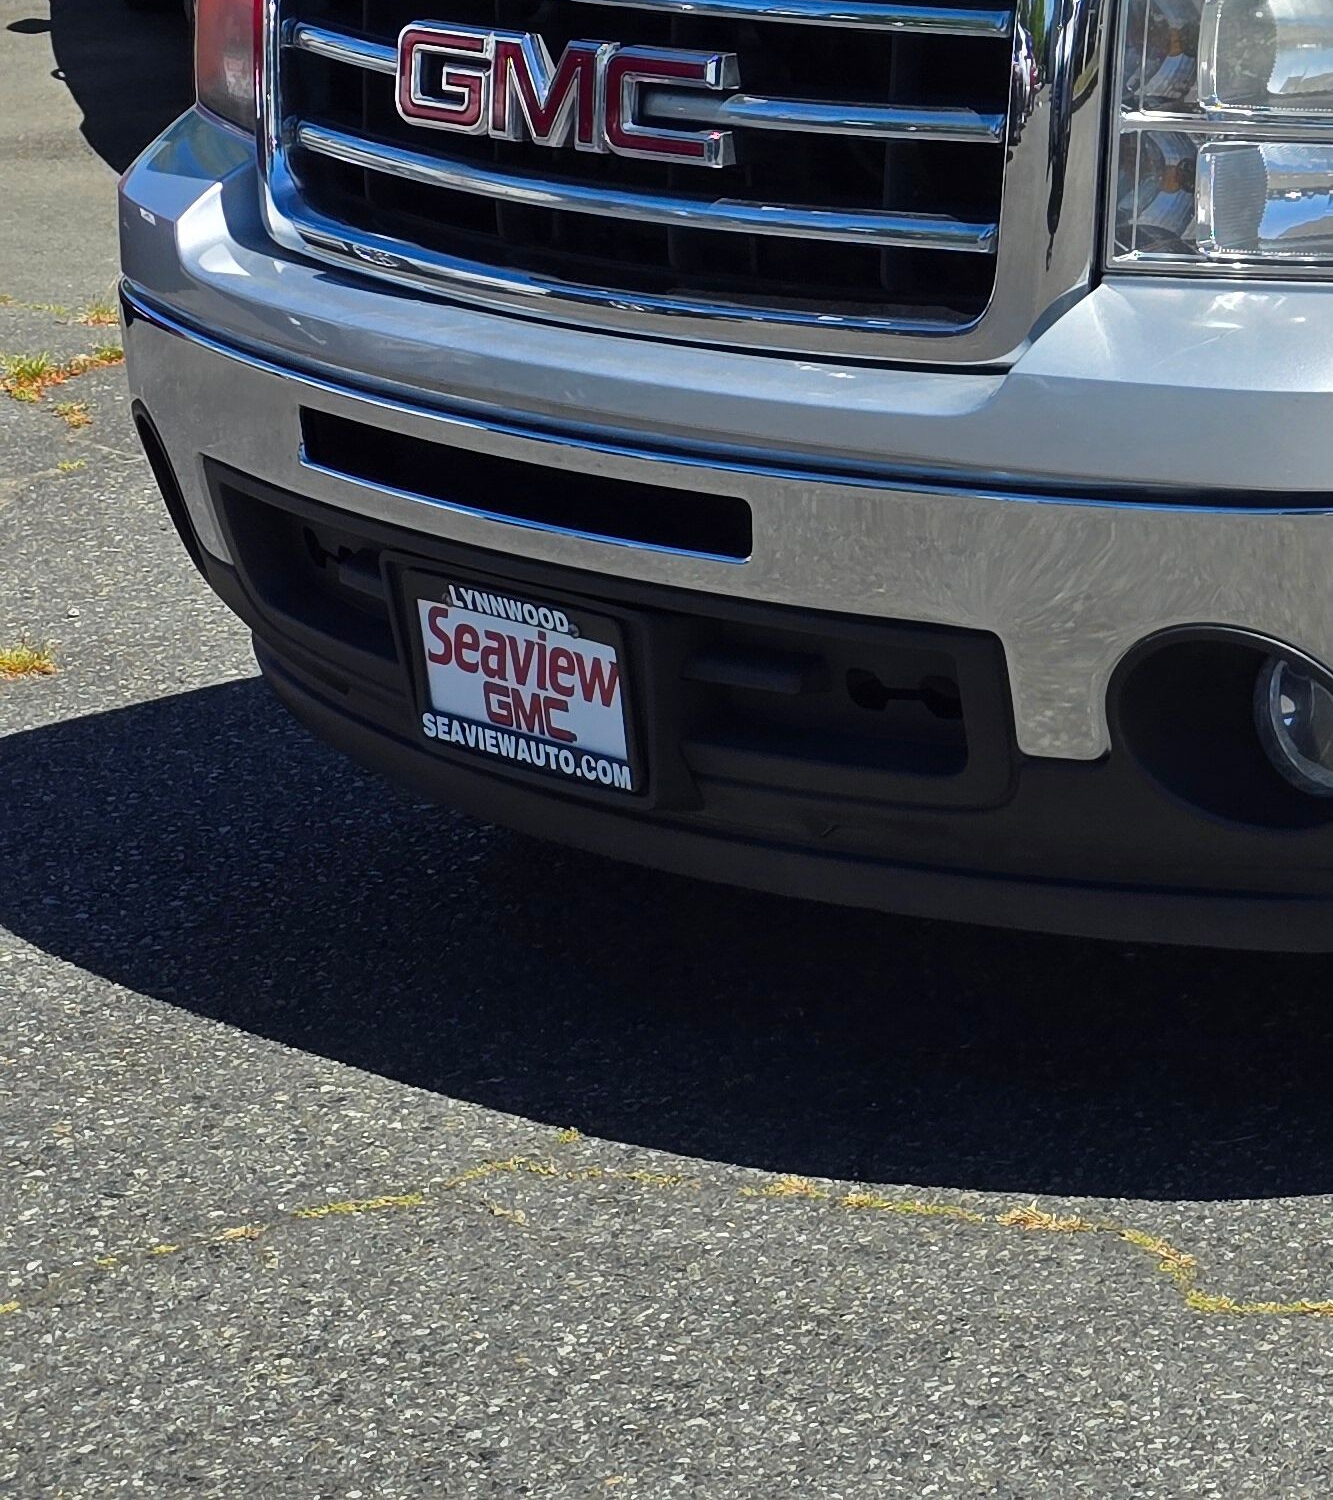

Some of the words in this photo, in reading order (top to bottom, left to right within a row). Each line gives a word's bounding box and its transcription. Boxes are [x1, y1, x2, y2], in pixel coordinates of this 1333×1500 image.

[395, 19, 741, 169] GMC
[448, 584, 570, 634] LYNNWOOD
[427, 605, 621, 708] Seaview
[421, 712, 633, 792] SEAVIEWAUTO.COM
[482, 680, 578, 744] GMC
